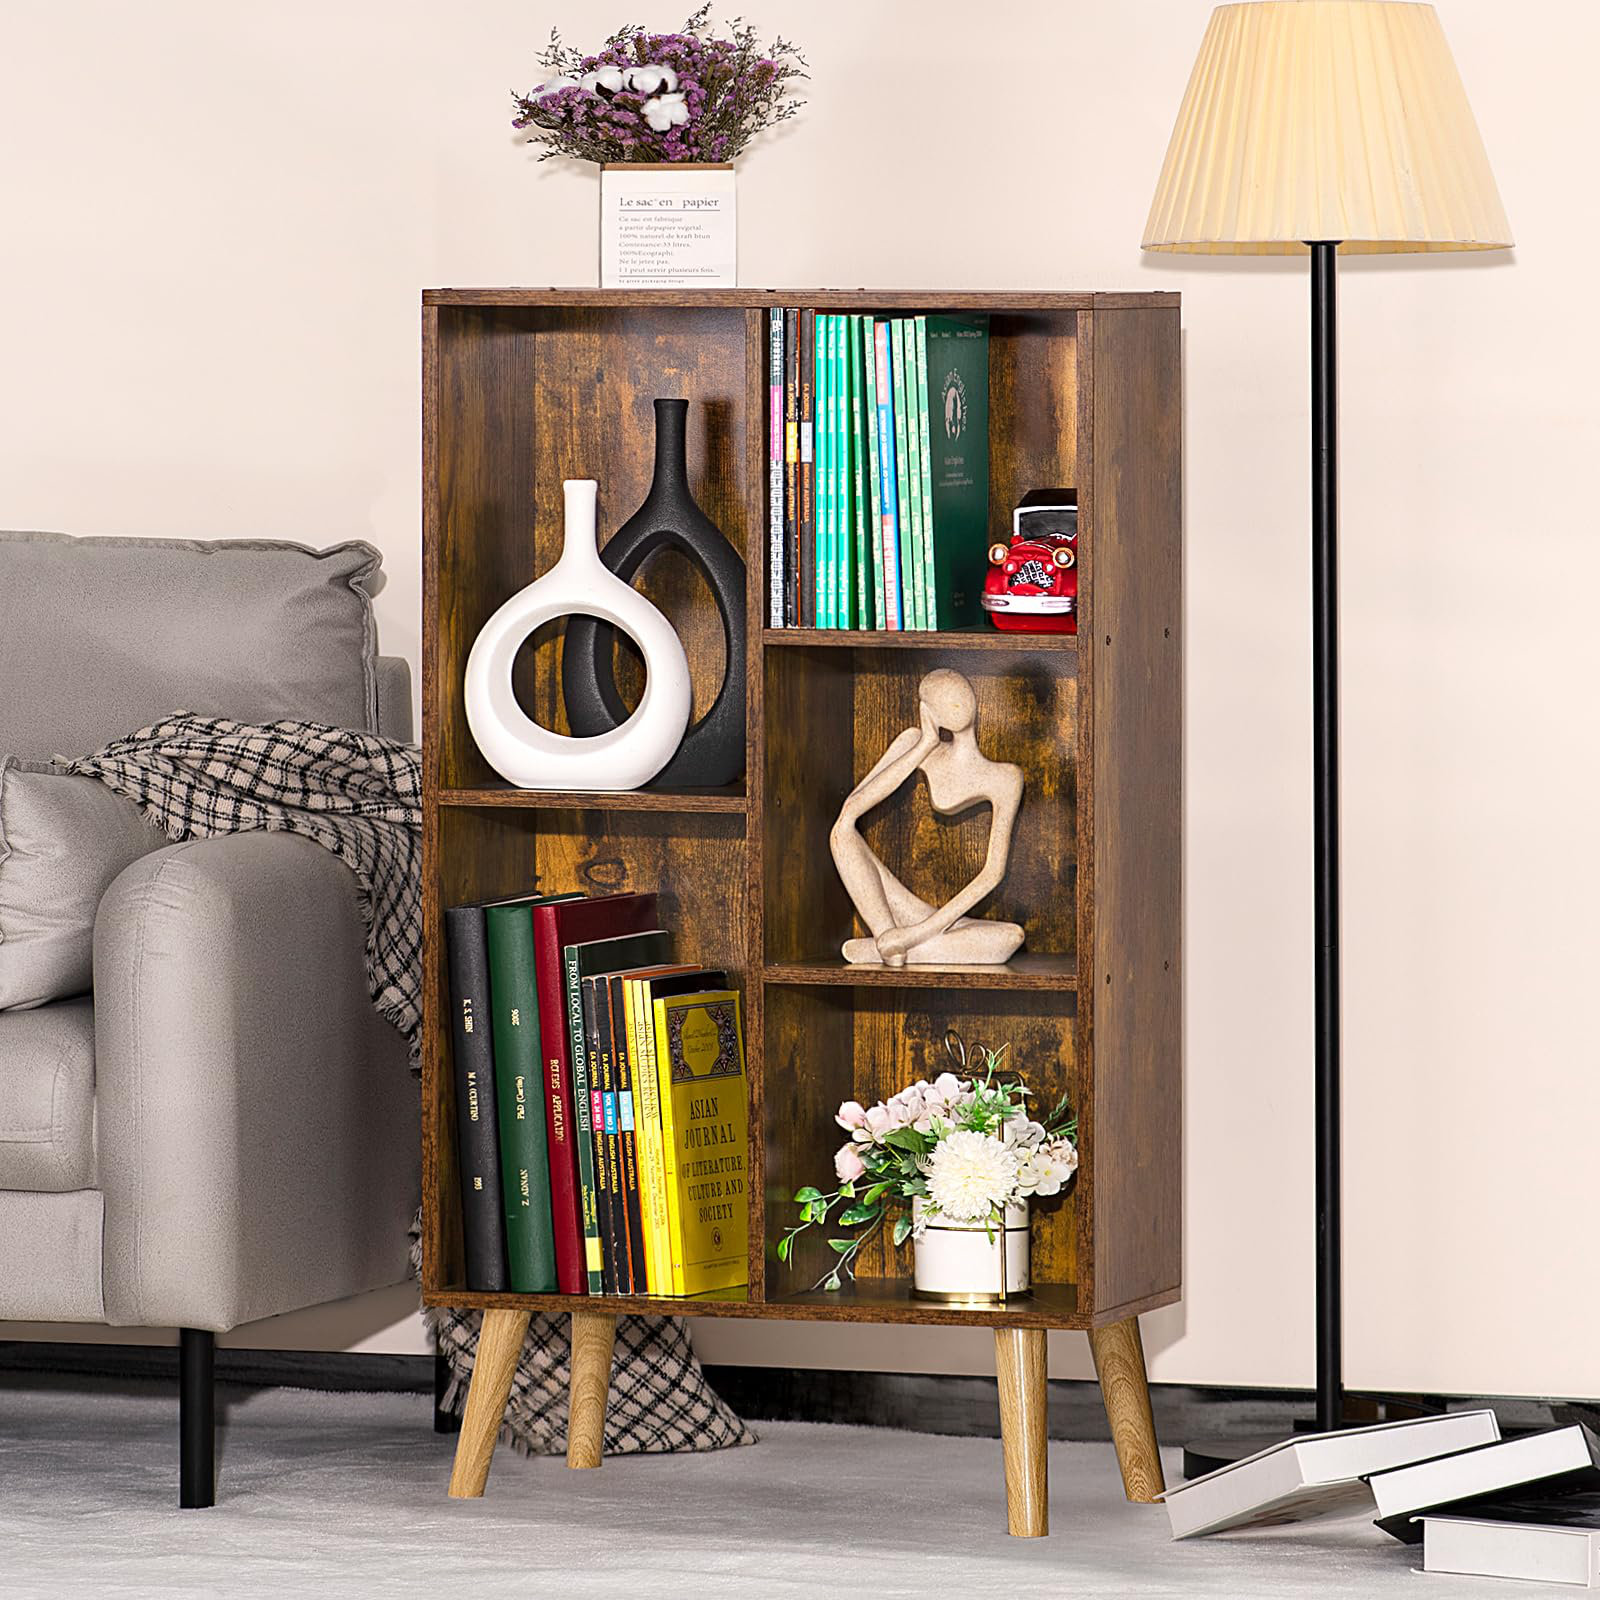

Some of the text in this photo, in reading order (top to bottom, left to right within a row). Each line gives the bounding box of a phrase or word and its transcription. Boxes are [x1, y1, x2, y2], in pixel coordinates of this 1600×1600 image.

[620, 197, 634, 206] Le
[683, 197, 719, 208] papier
[953, 367, 968, 432] Englishes
[464, 1015, 473, 1033] SHIN
[511, 1008, 519, 1026] 2006
[569, 960, 589, 1131] FROM LOCAL TO GLOBAL ENGLISH
[590, 1051, 599, 1088] EA JOURNAL
[602, 1053, 611, 1090] EA JOURNAL
[618, 1052, 628, 1089] EA JOURNAL
[515, 1075, 525, 1103] (Curtin)
[690, 1097, 719, 1121] ASIAN
[684, 1123, 737, 1150] JOURNAL
[596, 1131, 606, 1191] ENGLISH AUSTRALIA
[609, 1135, 618, 1194] ENGLISH AUSTRALIA
[625, 1132, 636, 1191] ENGLISH AUSTRALIA
[520, 1169, 529, 1197] ADNAN
[688, 1178, 744, 1202] CULTURE AND
[698, 1203, 734, 1224] SOCIETY
